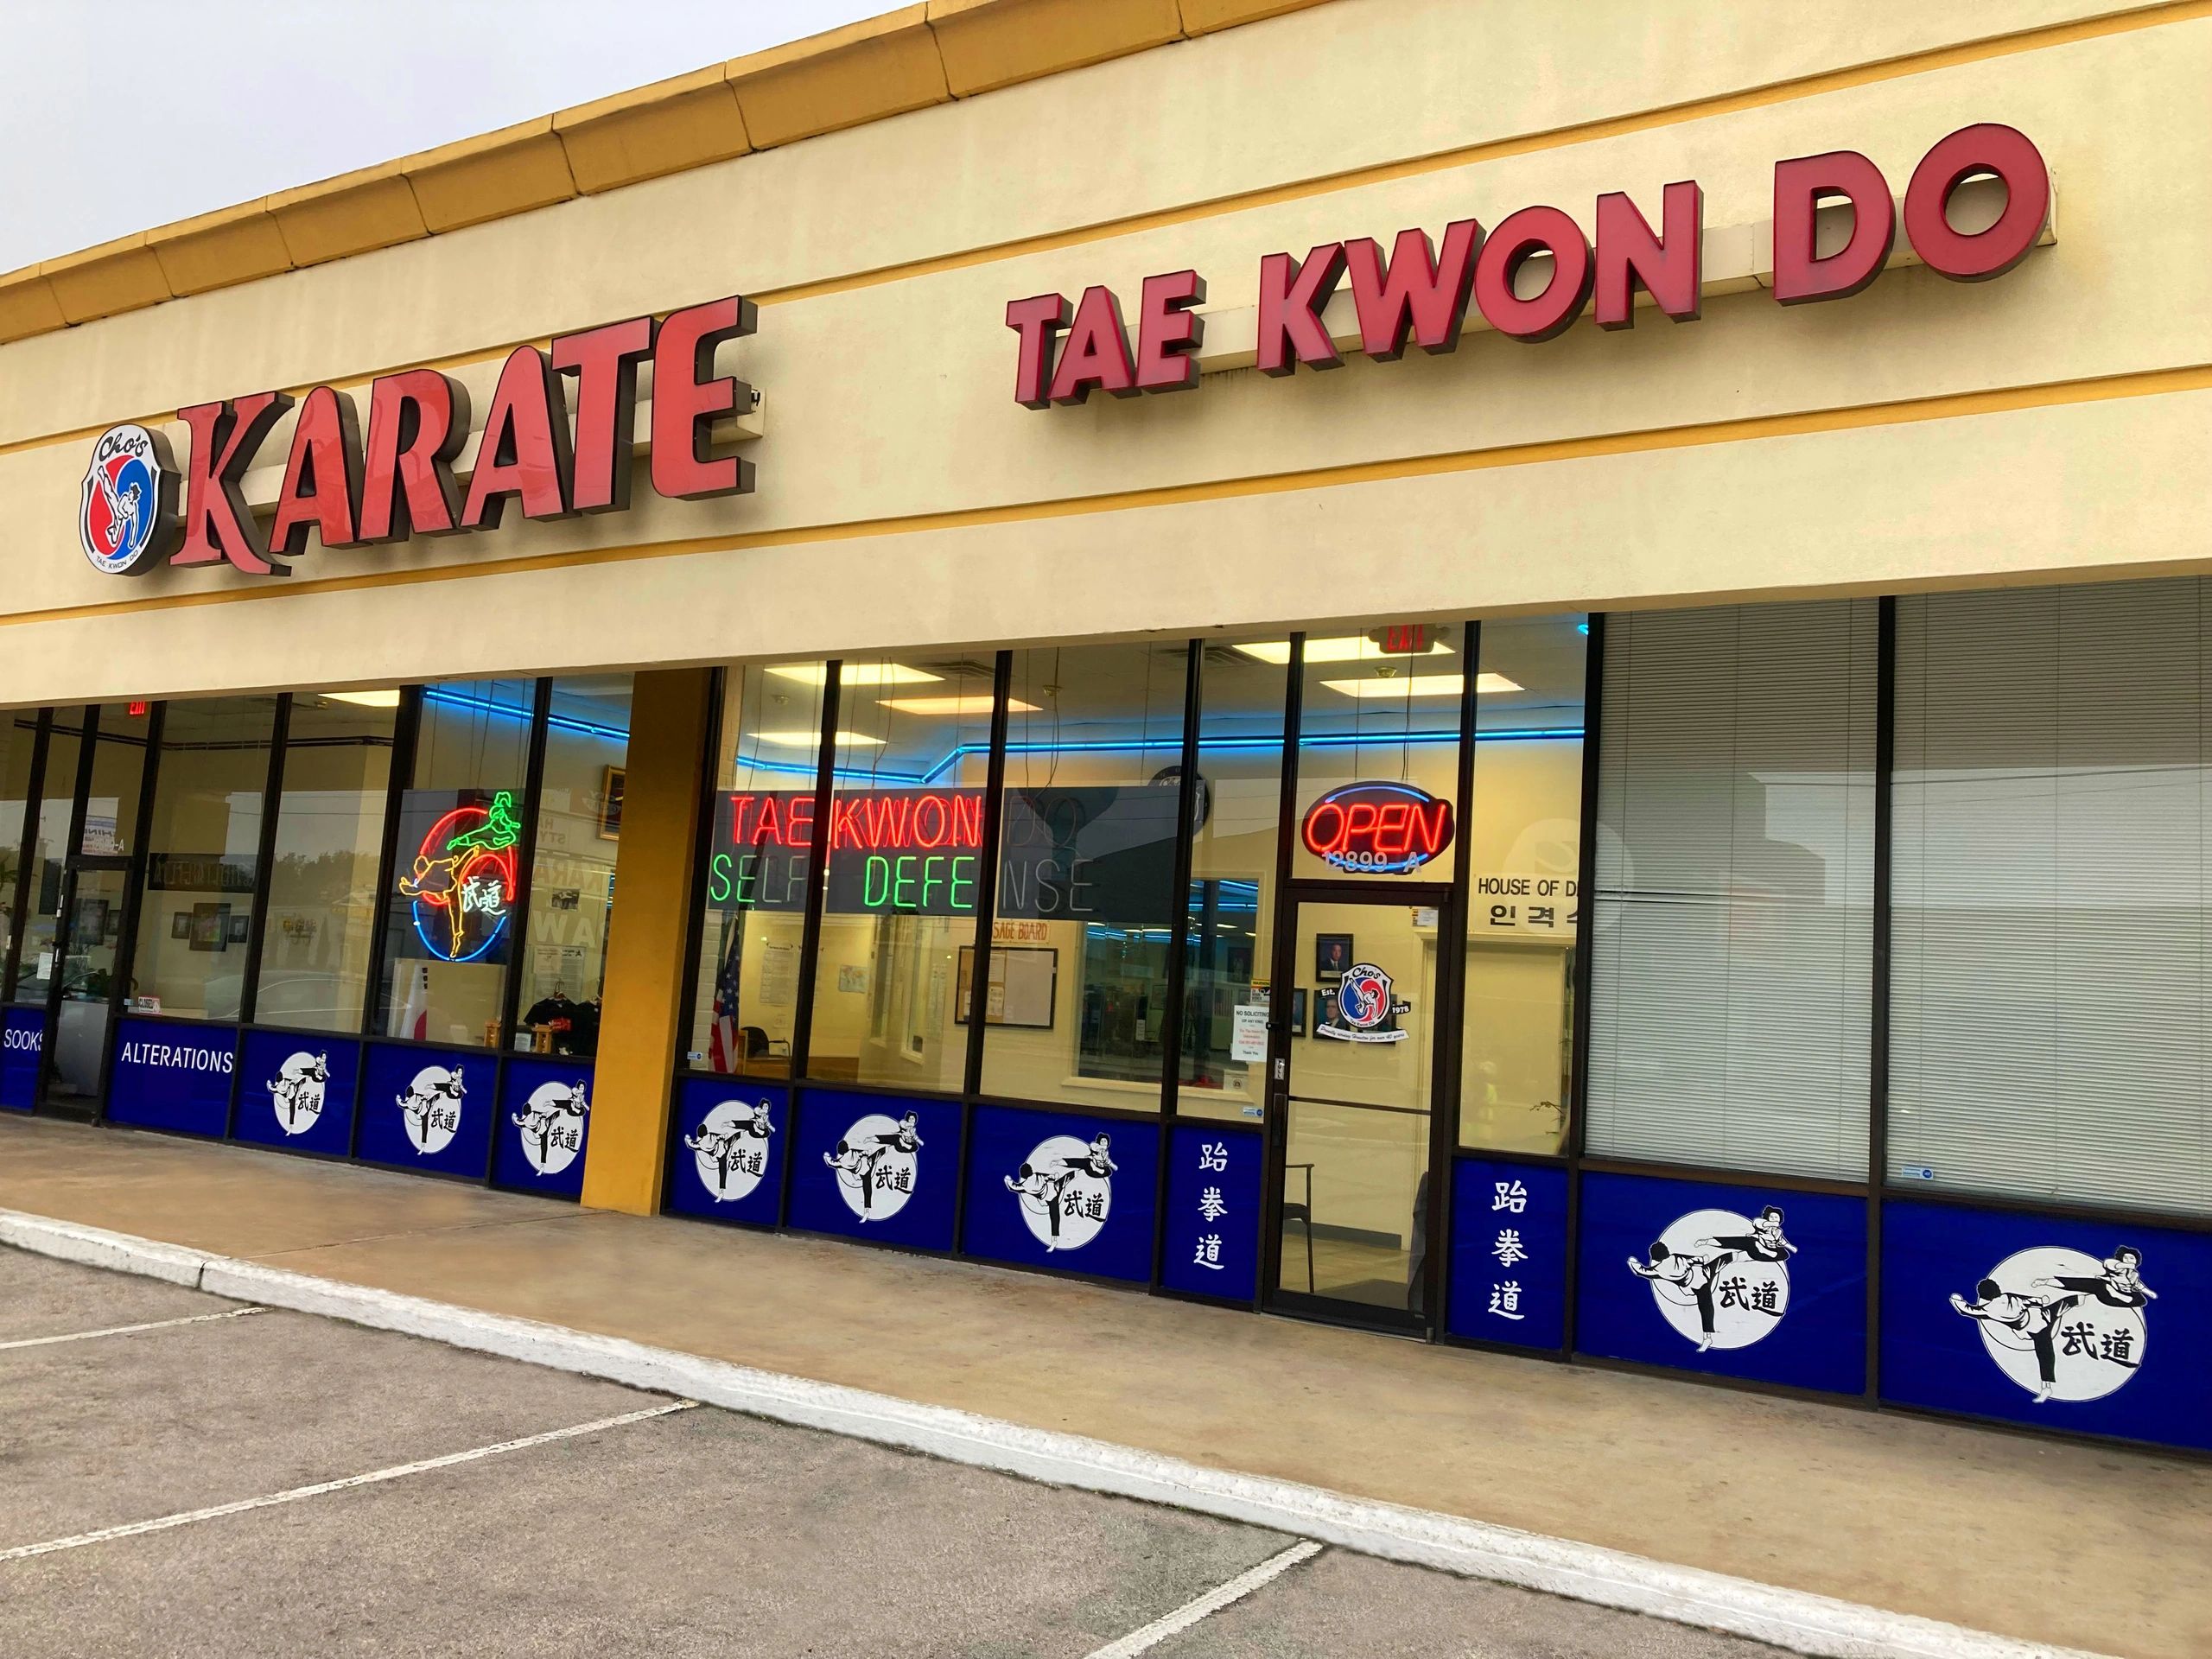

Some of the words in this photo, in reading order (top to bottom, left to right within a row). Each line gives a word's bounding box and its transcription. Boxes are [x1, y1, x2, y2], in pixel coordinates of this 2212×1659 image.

[1006, 270, 1205, 410] TAE
[1255, 179, 1705, 378] KWON
[1773, 122, 2052, 306] DO
[99, 432, 148, 462] Cho's
[168, 295, 758, 577] KARATE
[96, 556, 106, 567] TAE
[108, 560, 127, 569] KWON
[130, 550, 138, 561] DO
[1388, 624, 1424, 651] EXIT
[731, 797, 815, 846] TAE
[834, 795, 982, 849] KWON
[1007, 796, 1077, 847] DO
[1306, 803, 1446, 854] OPEN
[710, 854, 808, 903] SELF
[1478, 878, 1531, 895] HOUSE
[1537, 880, 1560, 896] OF
[1566, 880, 1579, 897] D
[993, 922, 1014, 939] SAGE
[1018, 922, 1048, 941] BOARD
[1352, 966, 1381, 979] Cho's
[1392, 1005, 1409, 1014] 1978
[121, 1042, 233, 1073] ALTERATIONS
[297, 1090, 321, 1115] 武道
[431, 1108, 457, 1134] 武道
[550, 1125, 580, 1153] 武道
[730, 1149, 764, 1178] 武道
[875, 1163, 914, 1194] 武道
[1064, 1190, 1107, 1222] 武道
[1193, 1141, 1229, 1270] 跆拳道
[1487, 1179, 1529, 1320] 跆拳道
[1719, 1276, 1786, 1317] 武道
[2061, 1321, 2142, 1369] 武道
